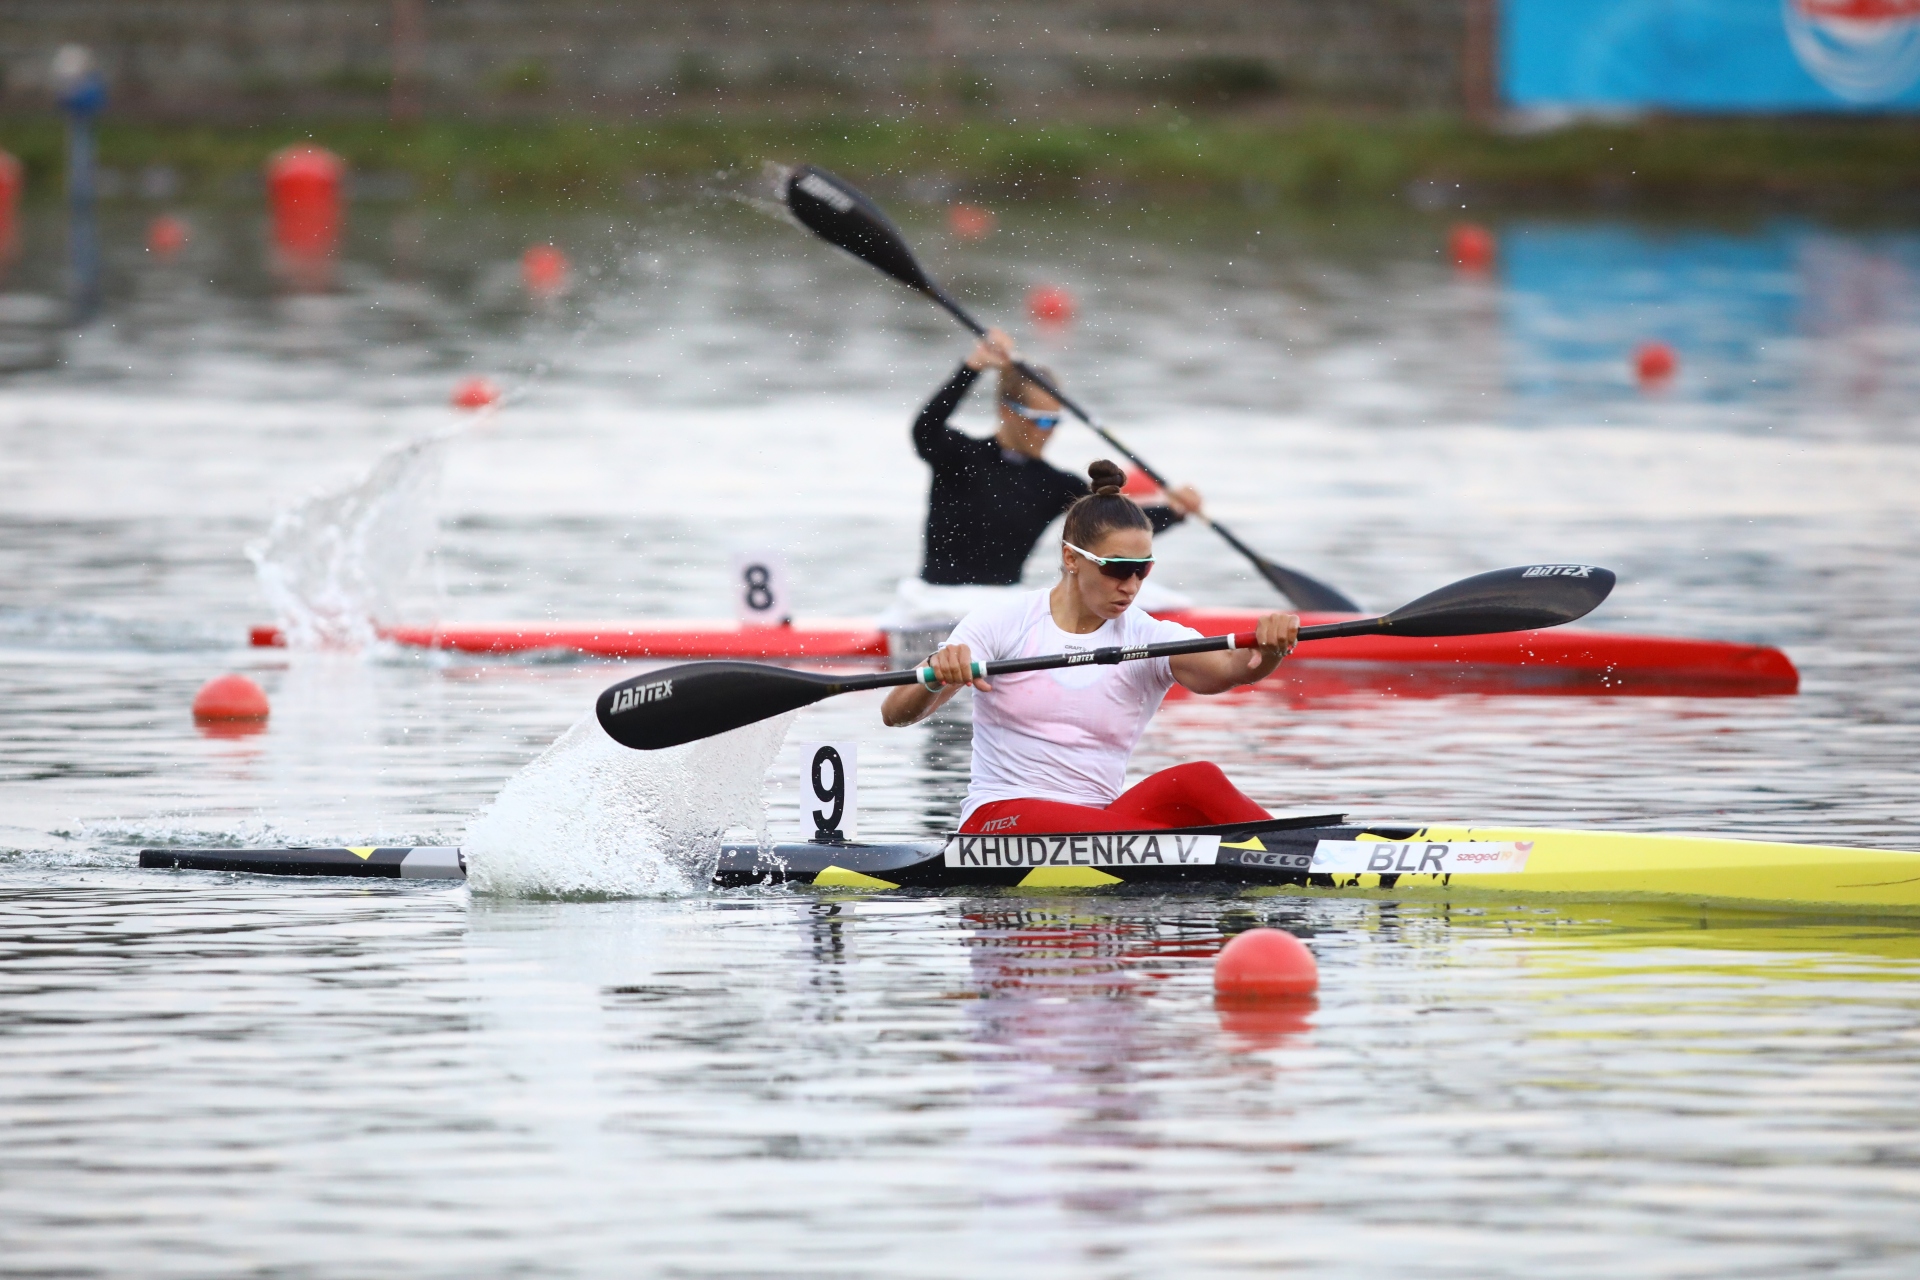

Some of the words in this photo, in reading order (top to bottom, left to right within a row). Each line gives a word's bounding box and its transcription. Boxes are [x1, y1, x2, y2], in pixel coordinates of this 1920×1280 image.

[743, 564, 774, 610] 8
[811, 745, 845, 831] 9
[958, 835, 1164, 866] KHUDZENKA
[1176, 836, 1200, 864] V.
[1366, 843, 1450, 872] BLR
